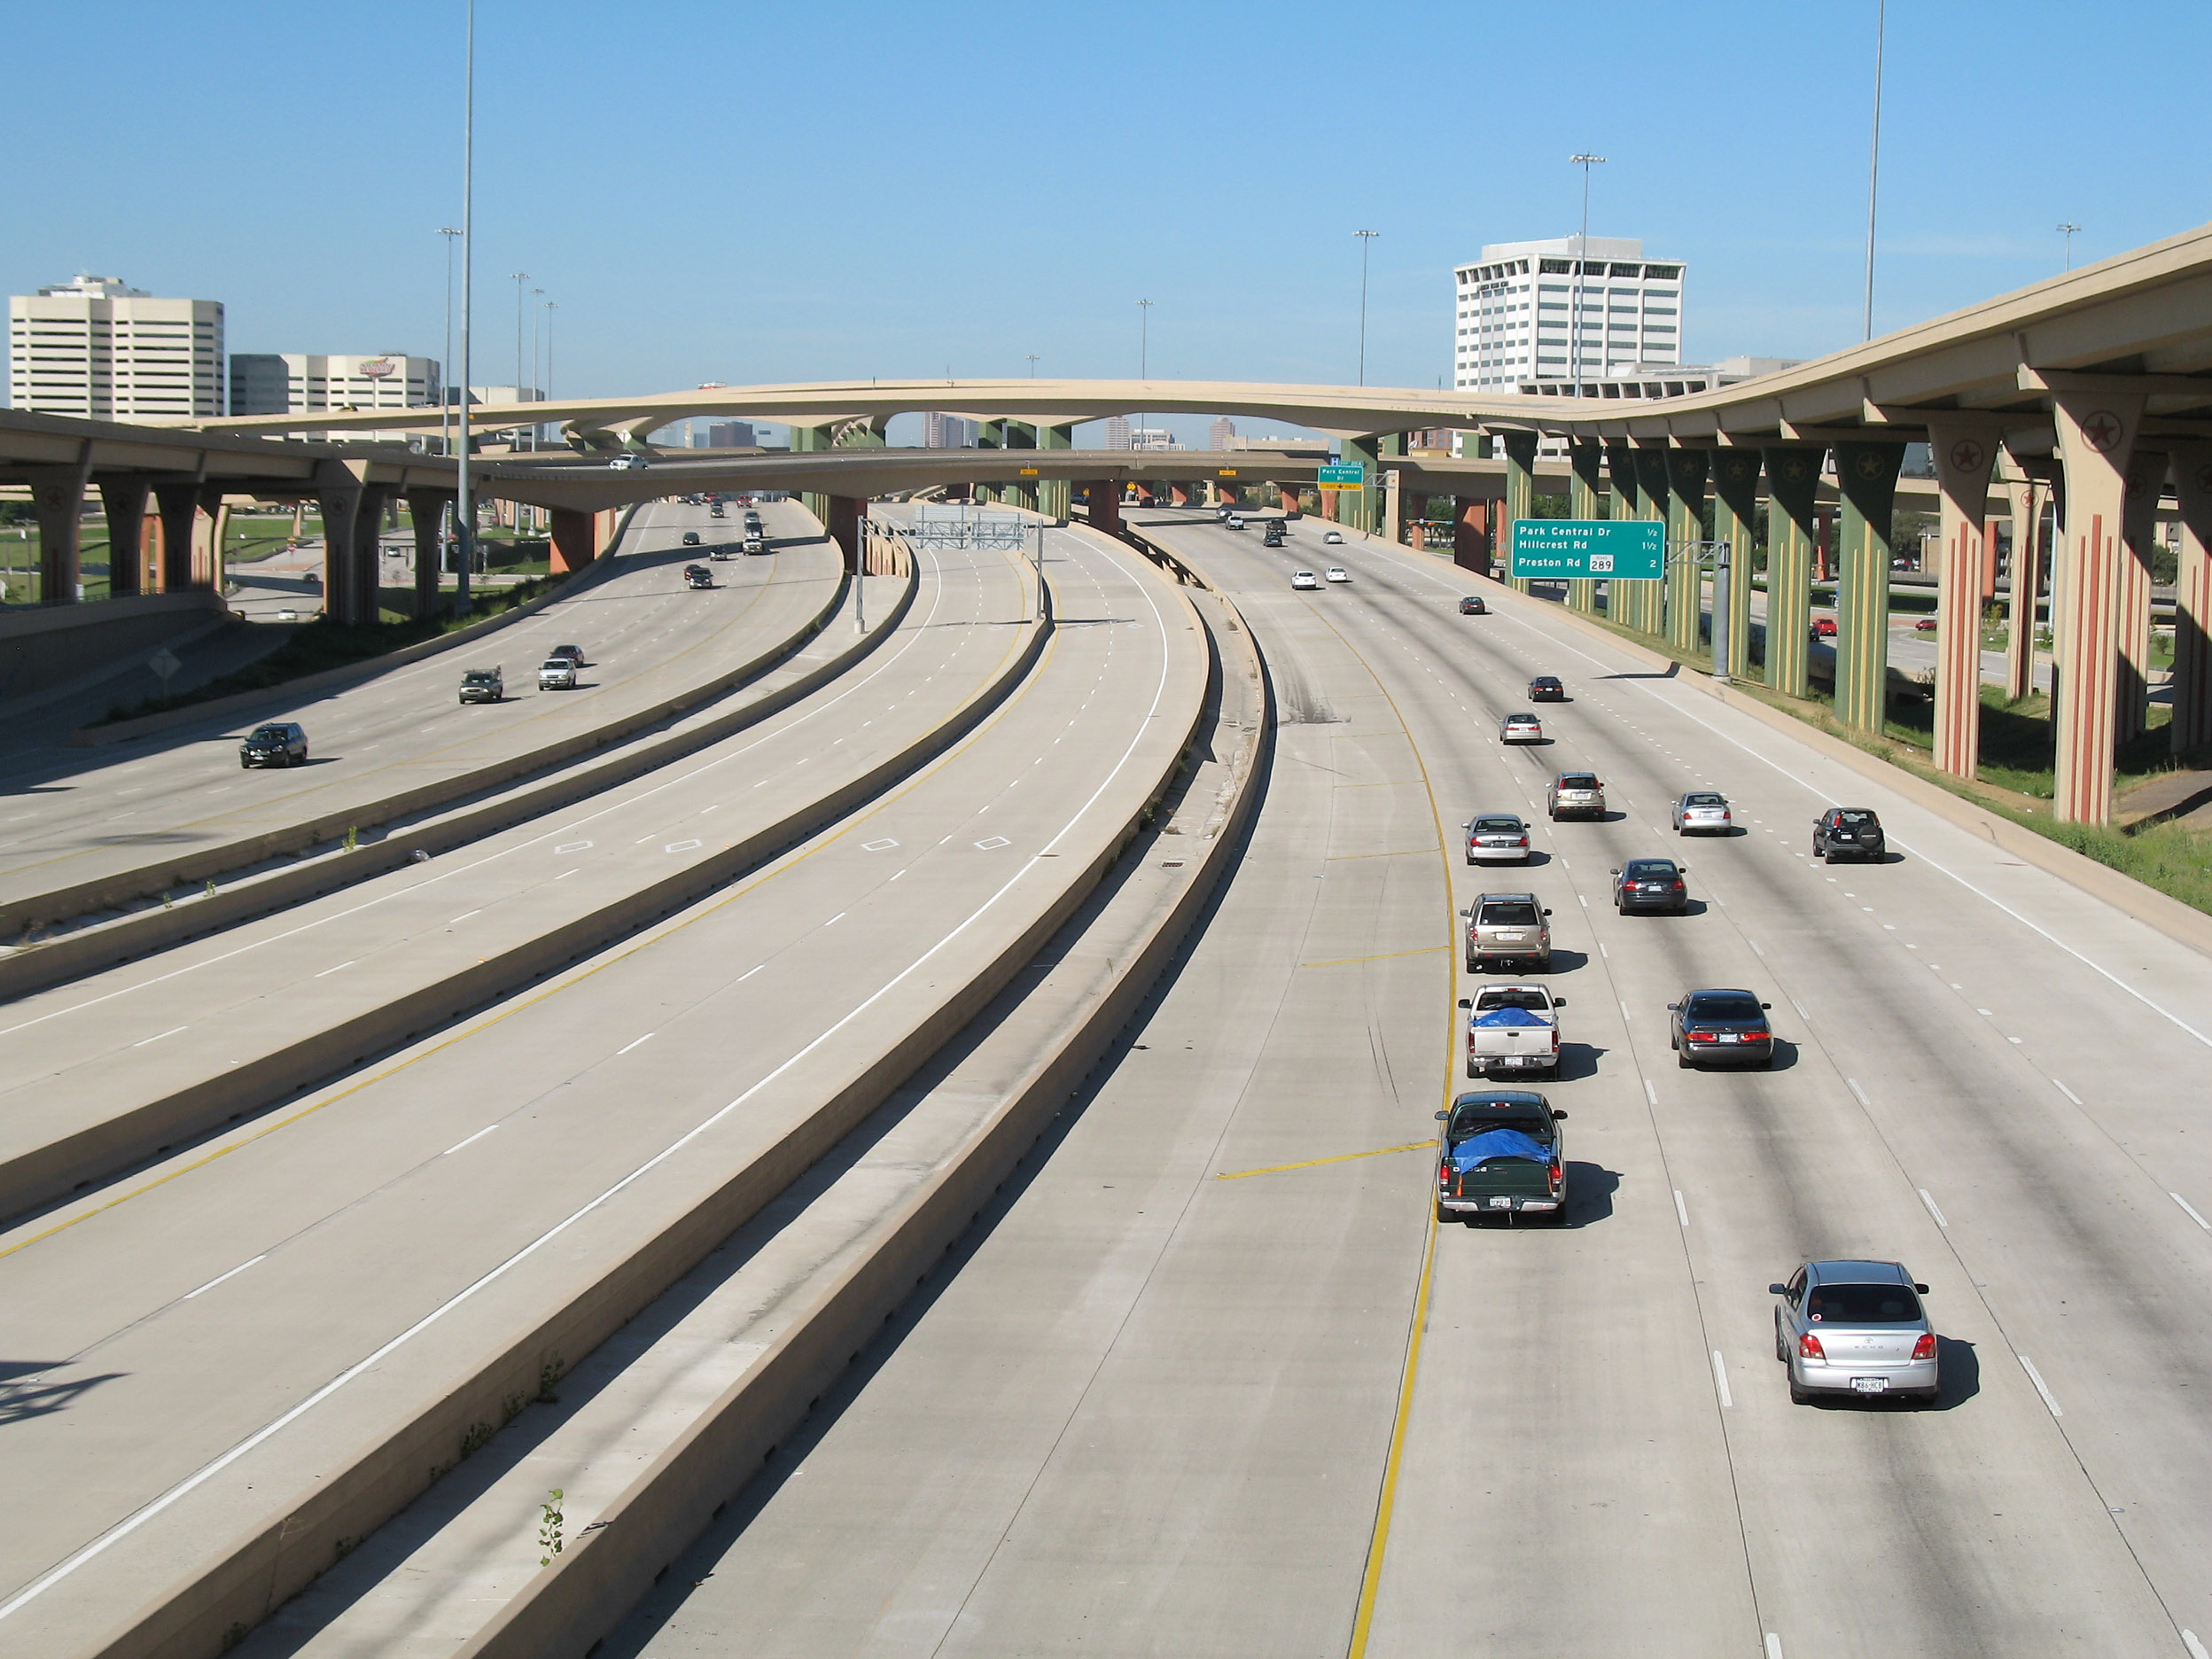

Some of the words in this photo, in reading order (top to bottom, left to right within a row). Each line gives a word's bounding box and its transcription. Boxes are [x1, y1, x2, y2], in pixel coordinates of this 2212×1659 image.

[1519, 526, 1546, 535] Park
[1551, 527, 1593, 536] Central
[1598, 527, 1611, 536] Dr
[1519, 540, 1568, 549] Hillcrest
[1573, 541, 1588, 549] Rd
[1518, 557, 1562, 566] Preston
[1566, 558, 1581, 567] Rd
[1591, 560, 1612, 570] 289
[1649, 559, 1657, 568] 2
